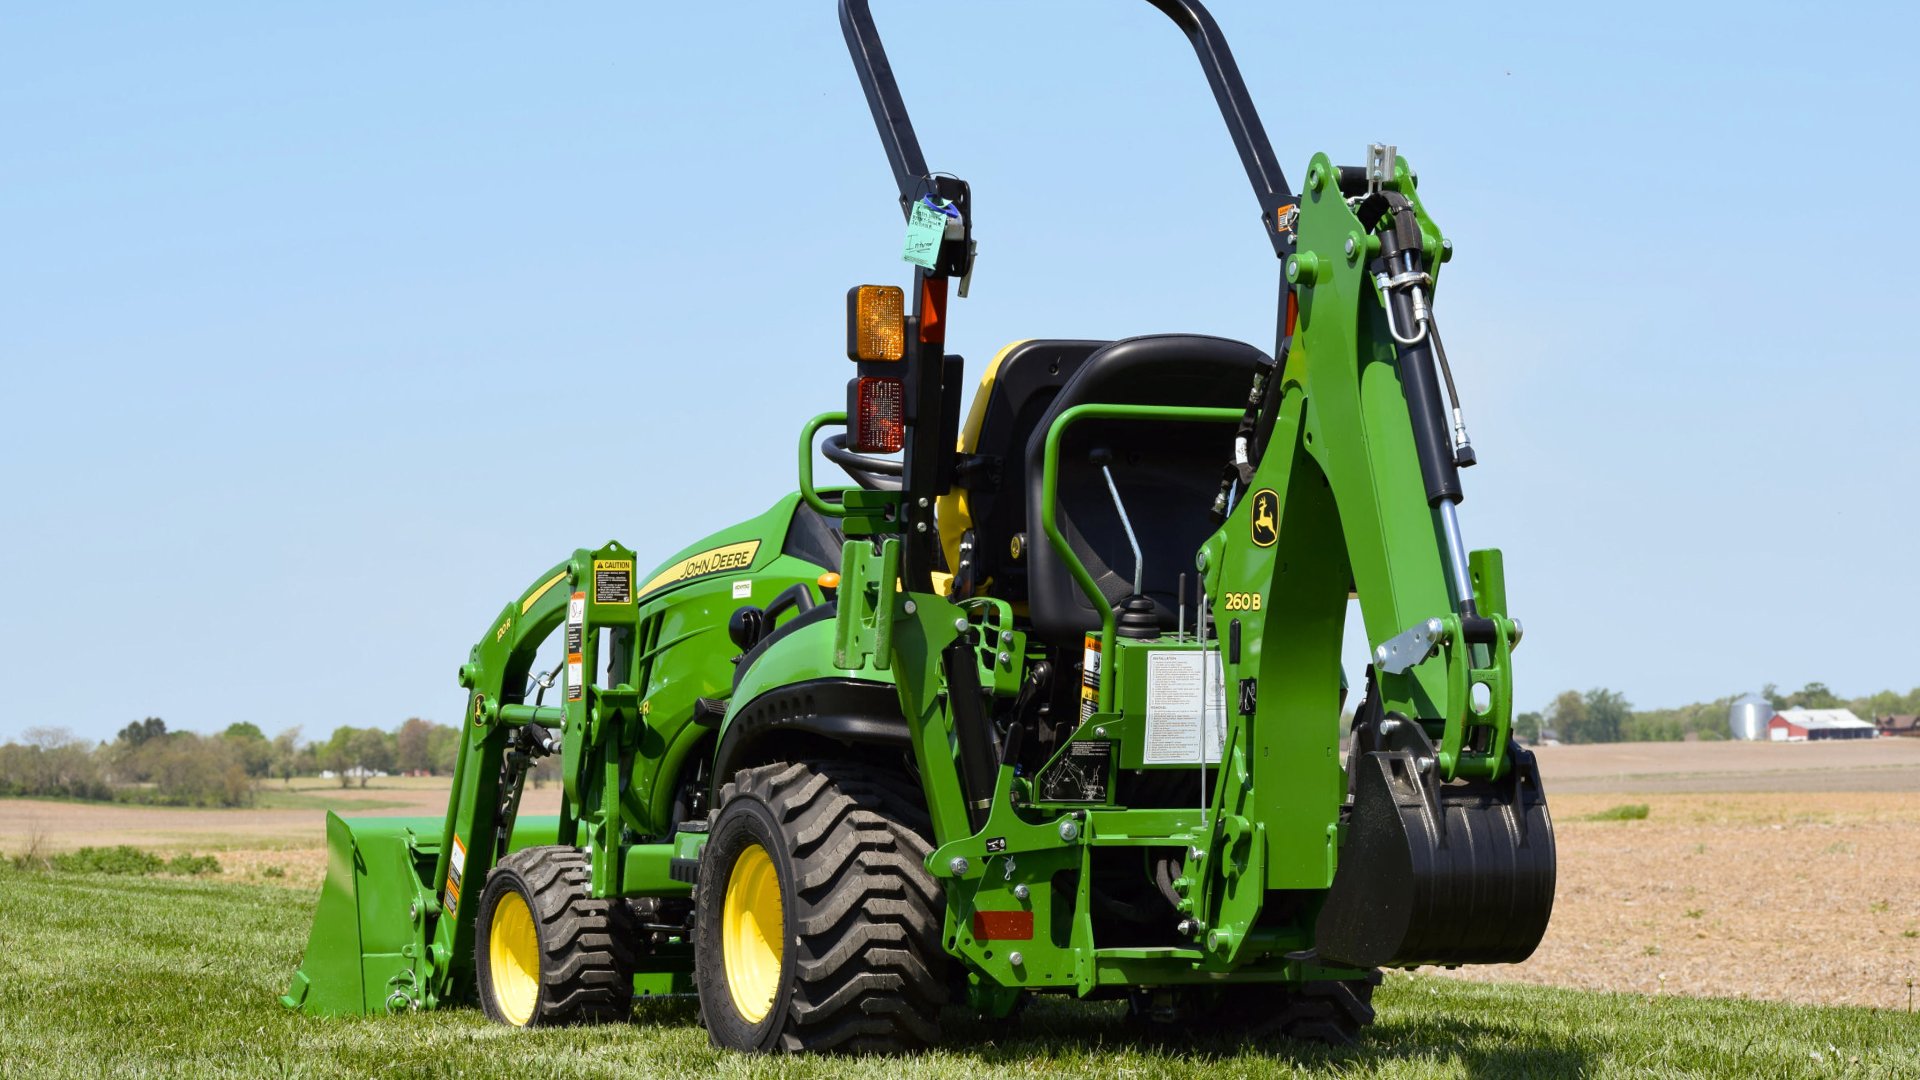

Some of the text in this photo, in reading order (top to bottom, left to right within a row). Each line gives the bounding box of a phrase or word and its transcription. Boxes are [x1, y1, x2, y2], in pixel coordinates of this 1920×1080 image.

[604, 561, 630, 569] CAUTION
[680, 550, 750, 579] JOHN DEERE
[1225, 592, 1262, 611] 260 B
